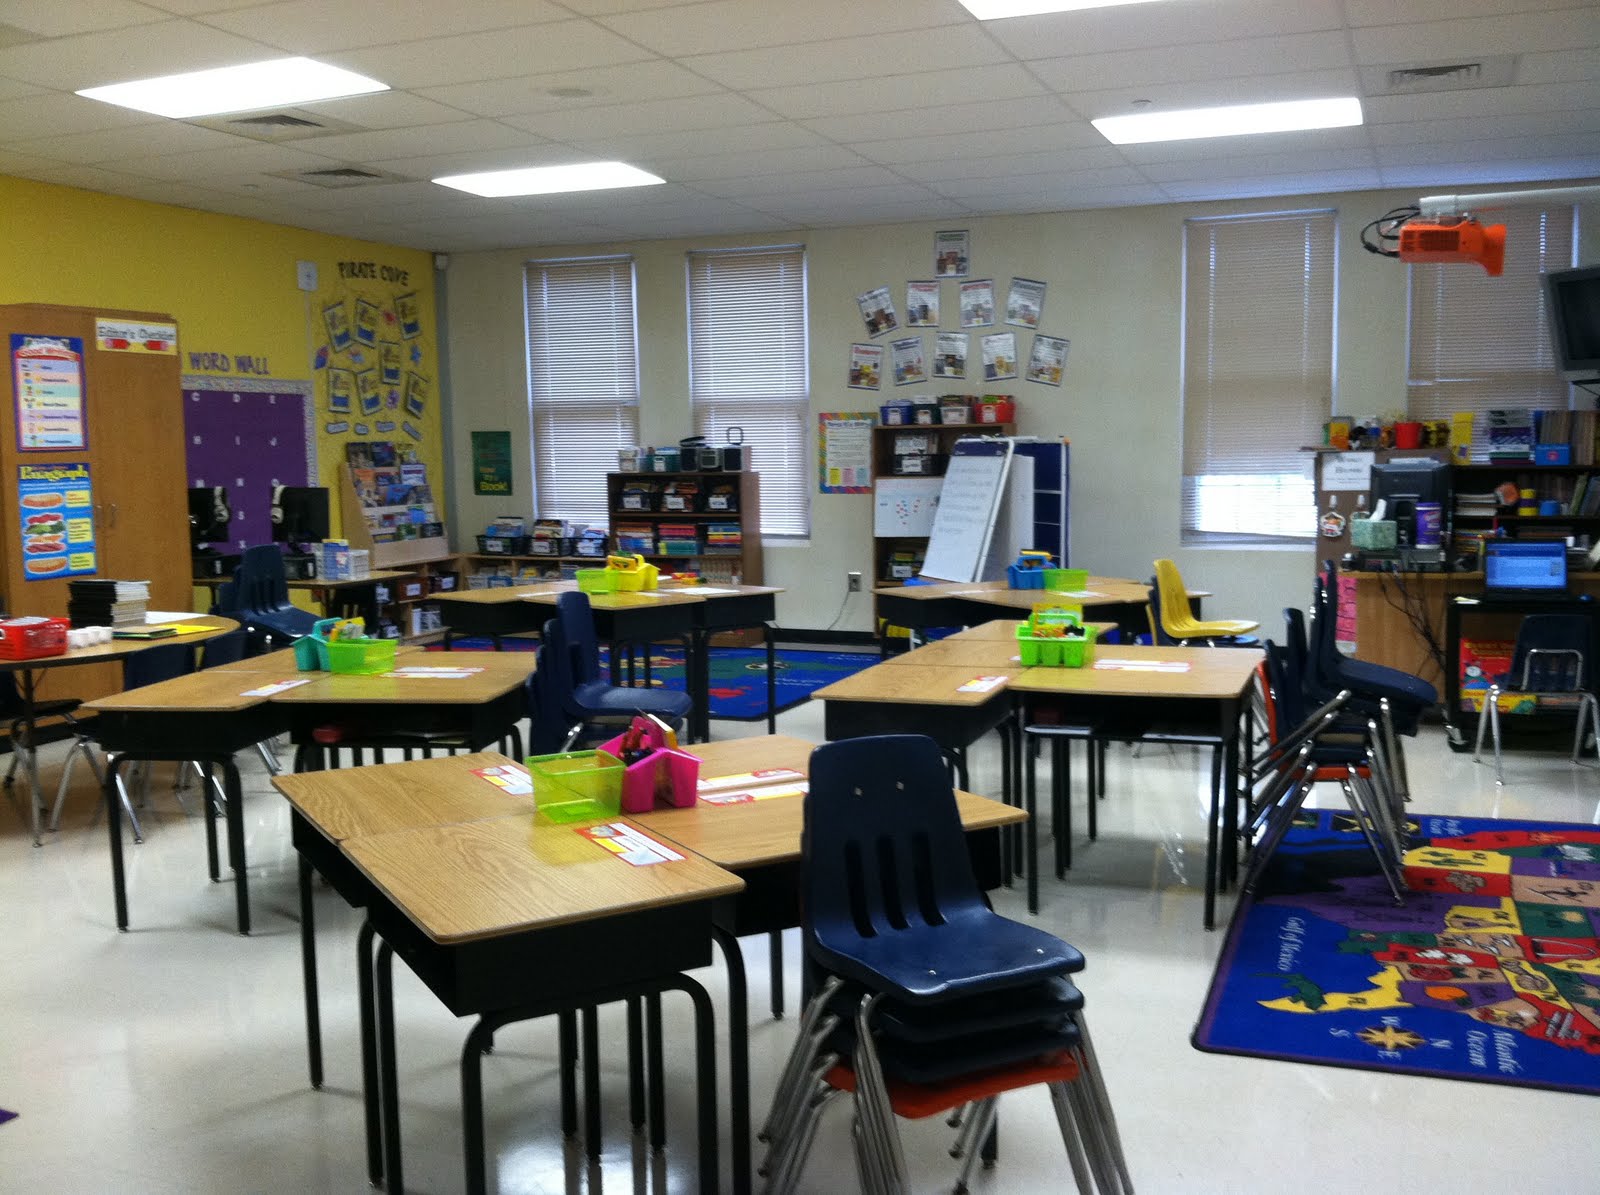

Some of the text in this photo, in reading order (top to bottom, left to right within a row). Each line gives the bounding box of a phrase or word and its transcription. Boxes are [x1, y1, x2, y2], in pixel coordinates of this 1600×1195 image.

[338, 261, 409, 287] PIRATE COVE
[189, 351, 271, 376] WORD WALL
[1279, 916, 1307, 936] Gulf
[1277, 941, 1302, 972] Mexico
[1328, 1026, 1353, 1039] S
[1380, 1015, 1401, 1028] W
[1428, 1037, 1454, 1050] N
[1465, 1029, 1489, 1069] Ocean
[1492, 1027, 1525, 1075] Atlantic
[1377, 1049, 1402, 1061] E
